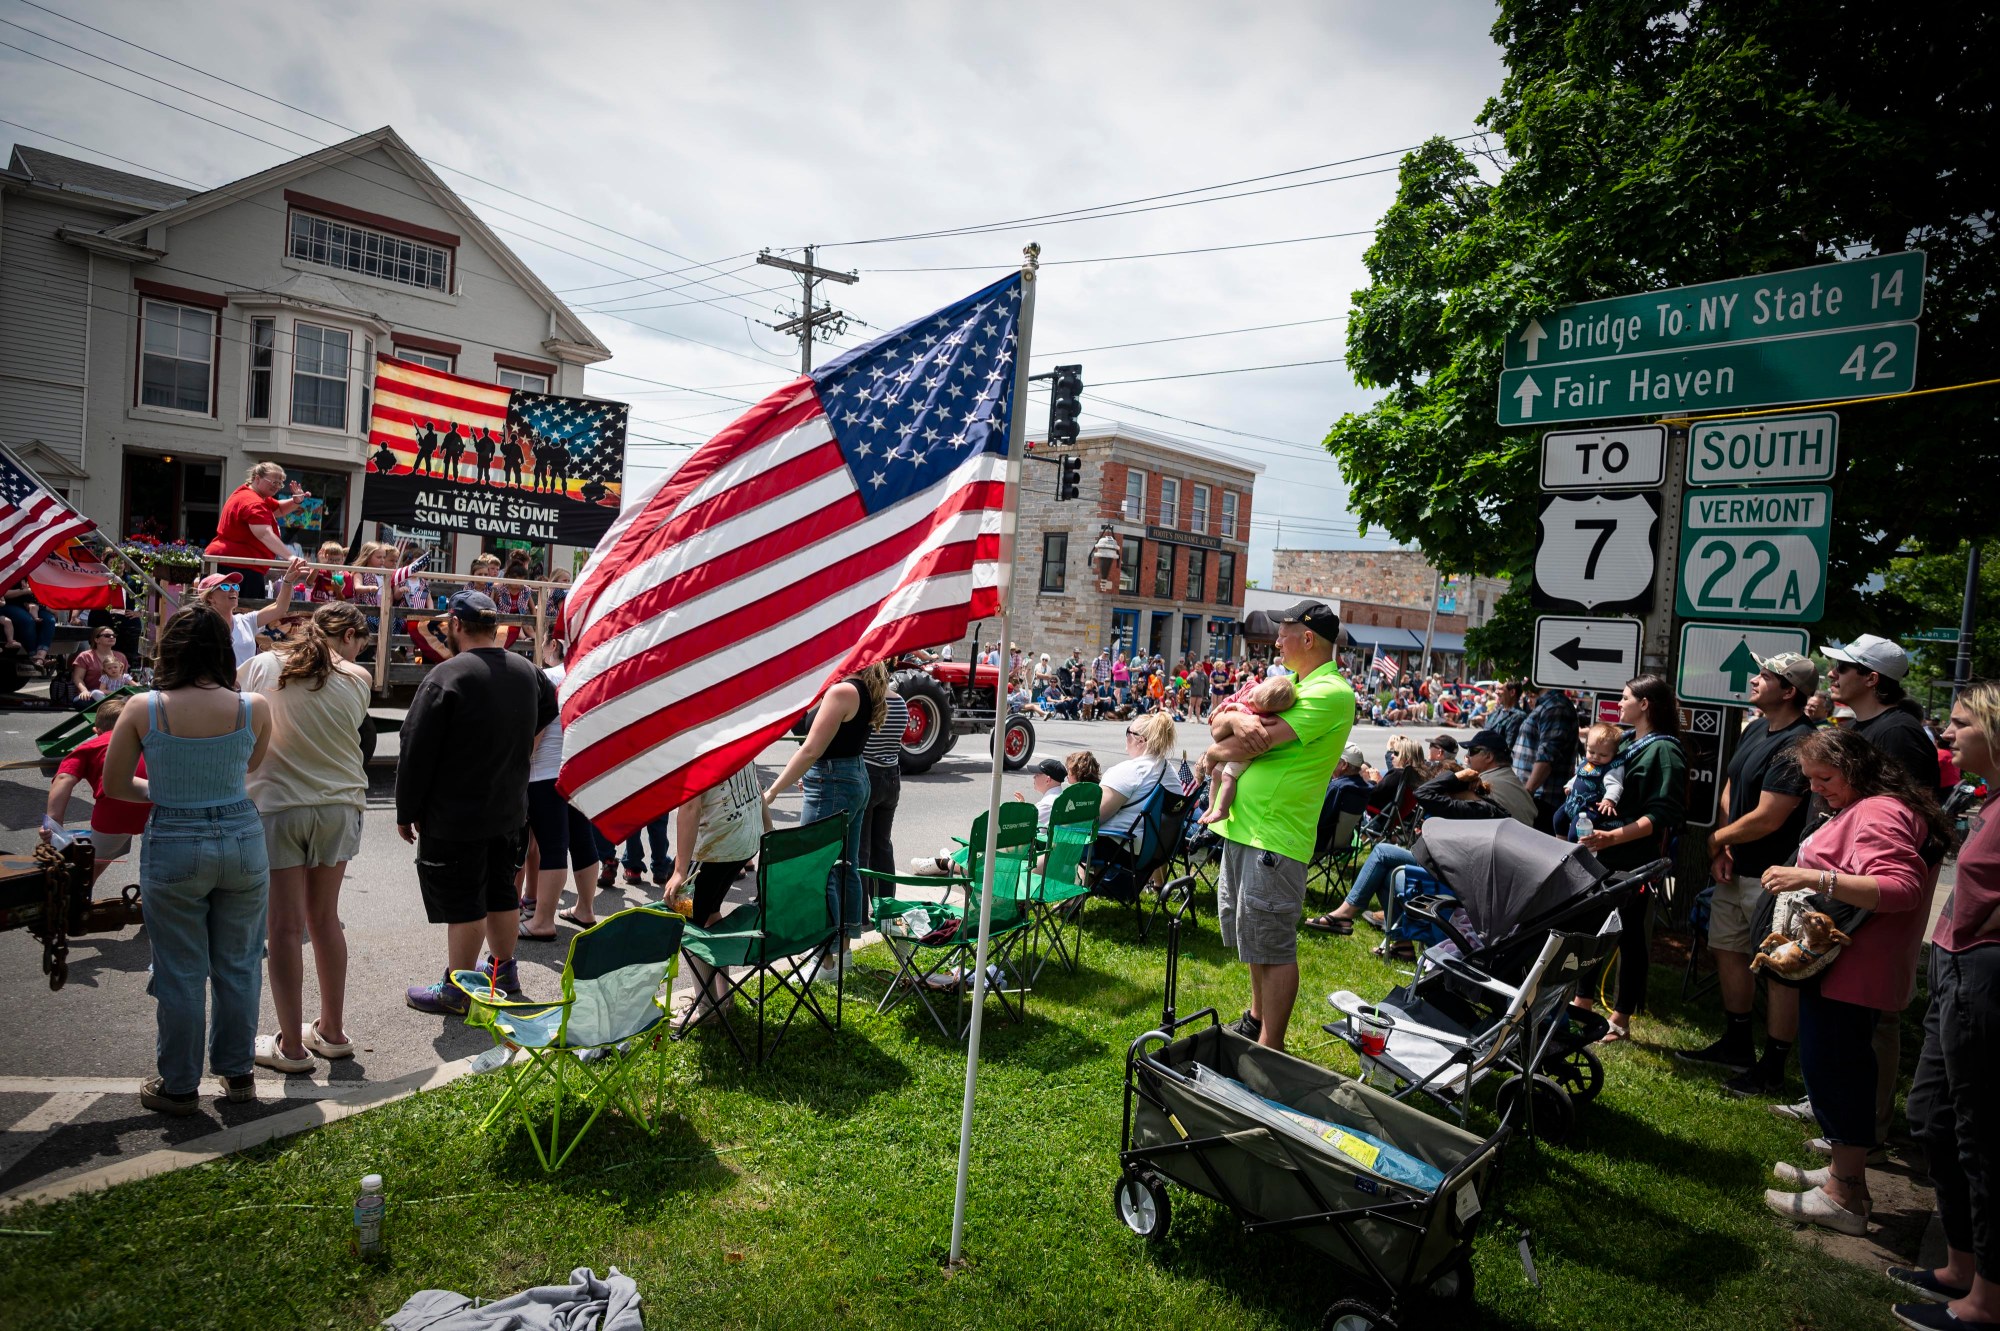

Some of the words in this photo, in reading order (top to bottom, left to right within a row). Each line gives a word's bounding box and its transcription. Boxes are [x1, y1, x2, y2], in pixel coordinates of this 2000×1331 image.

[1558, 312, 1642, 353] Bridge
[1657, 303, 1683, 337] To
[1699, 293, 1739, 332] NY
[1753, 281, 1843, 325] State
[1870, 269, 1904, 308] 14
[1553, 375, 1611, 408] Fair
[1629, 365, 1735, 402] Haven
[1840, 341, 1898, 381] 42
[1576, 441, 1629, 475] TO
[1700, 428, 1823, 471] SOUTH
[415, 491, 446, 509] ALL
[454, 498, 501, 517] GAVE
[507, 505, 560, 523] SOME
[1699, 497, 1815, 524] VERMONT
[414, 509, 469, 529] SOME
[475, 520, 521, 535] GAVE
[527, 525, 558, 540] ALL
[1174, 533, 1199, 544] INSURANCE
[1200, 538, 1217, 547] AGENCY
[1574, 519, 1618, 580] 7
[1689, 768, 1713, 783] on
